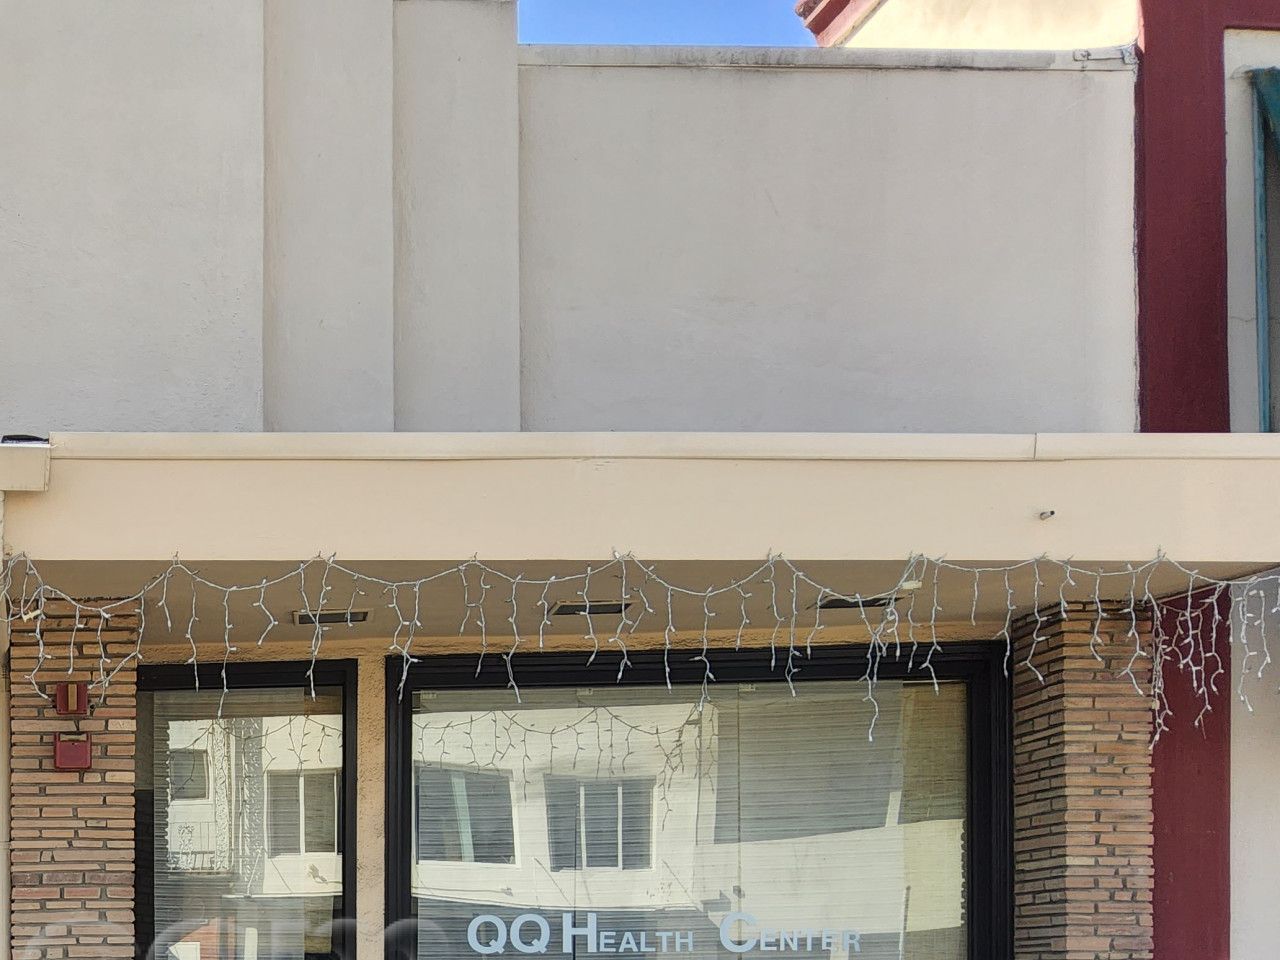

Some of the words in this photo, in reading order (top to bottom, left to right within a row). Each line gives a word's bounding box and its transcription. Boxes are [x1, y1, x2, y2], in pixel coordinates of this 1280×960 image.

[466, 913, 550, 955] QQ
[562, 913, 694, 953] HEALTH
[719, 912, 862, 953] CENTER
